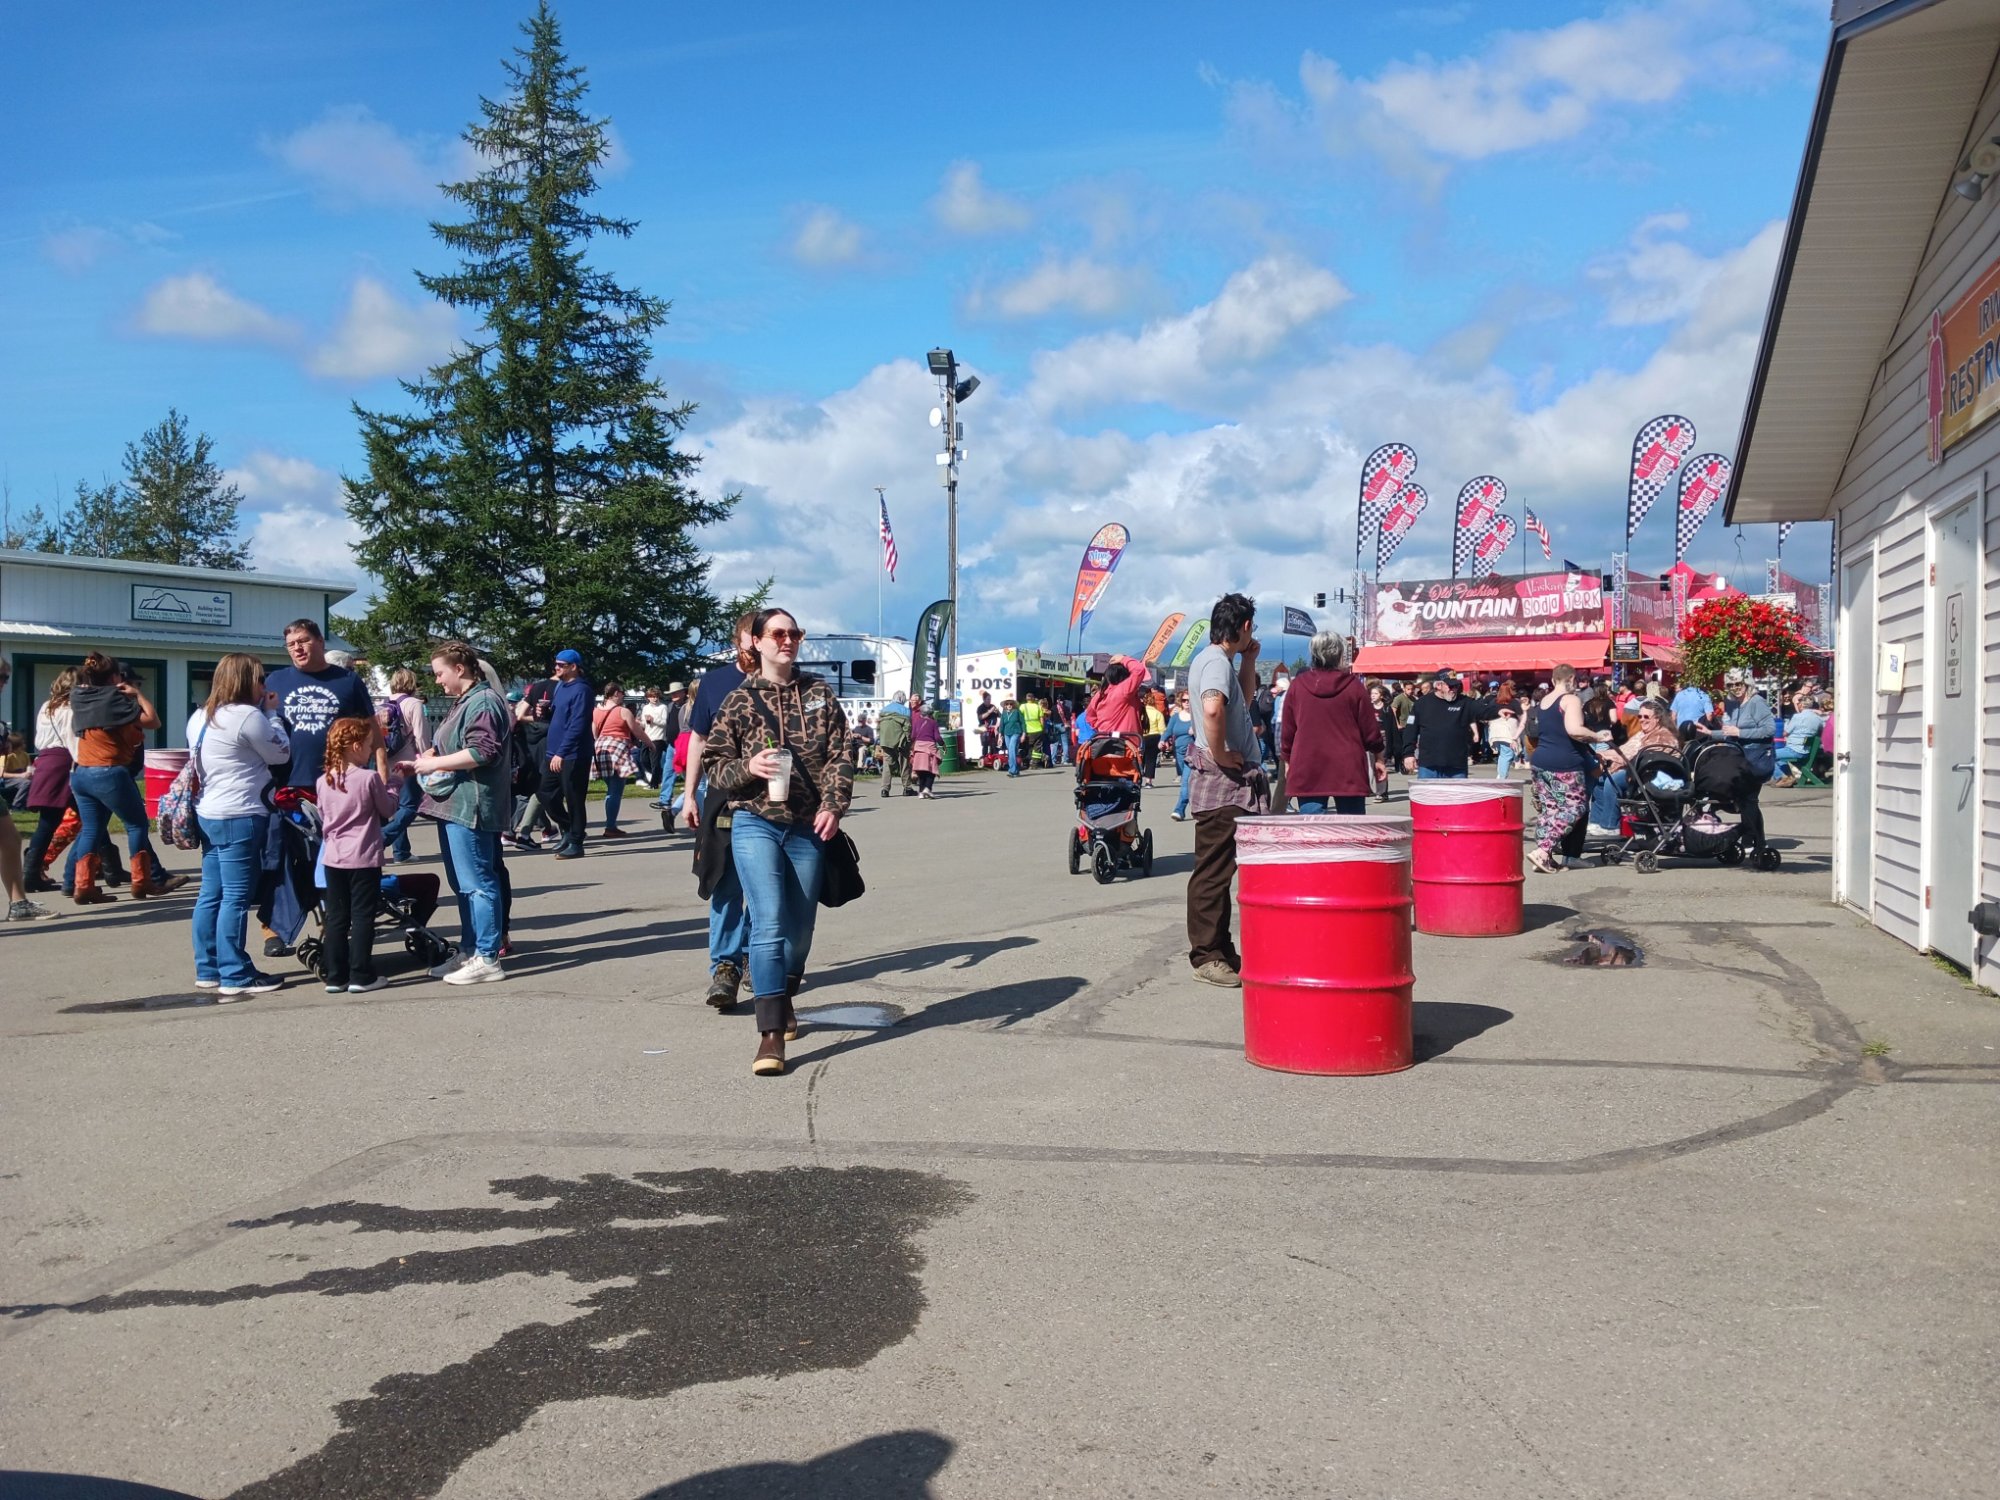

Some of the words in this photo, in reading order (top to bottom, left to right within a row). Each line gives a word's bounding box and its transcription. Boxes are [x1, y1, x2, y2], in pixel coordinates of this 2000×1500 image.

[1411, 597, 1517, 620] FOUNTAIN
[926, 613, 941, 667] HERE!
[1159, 618, 1178, 645] FISH
[1187, 624, 1205, 650] FISH
[297, 685, 340, 705] FAVORITE
[971, 678, 1012, 690] DOTS
